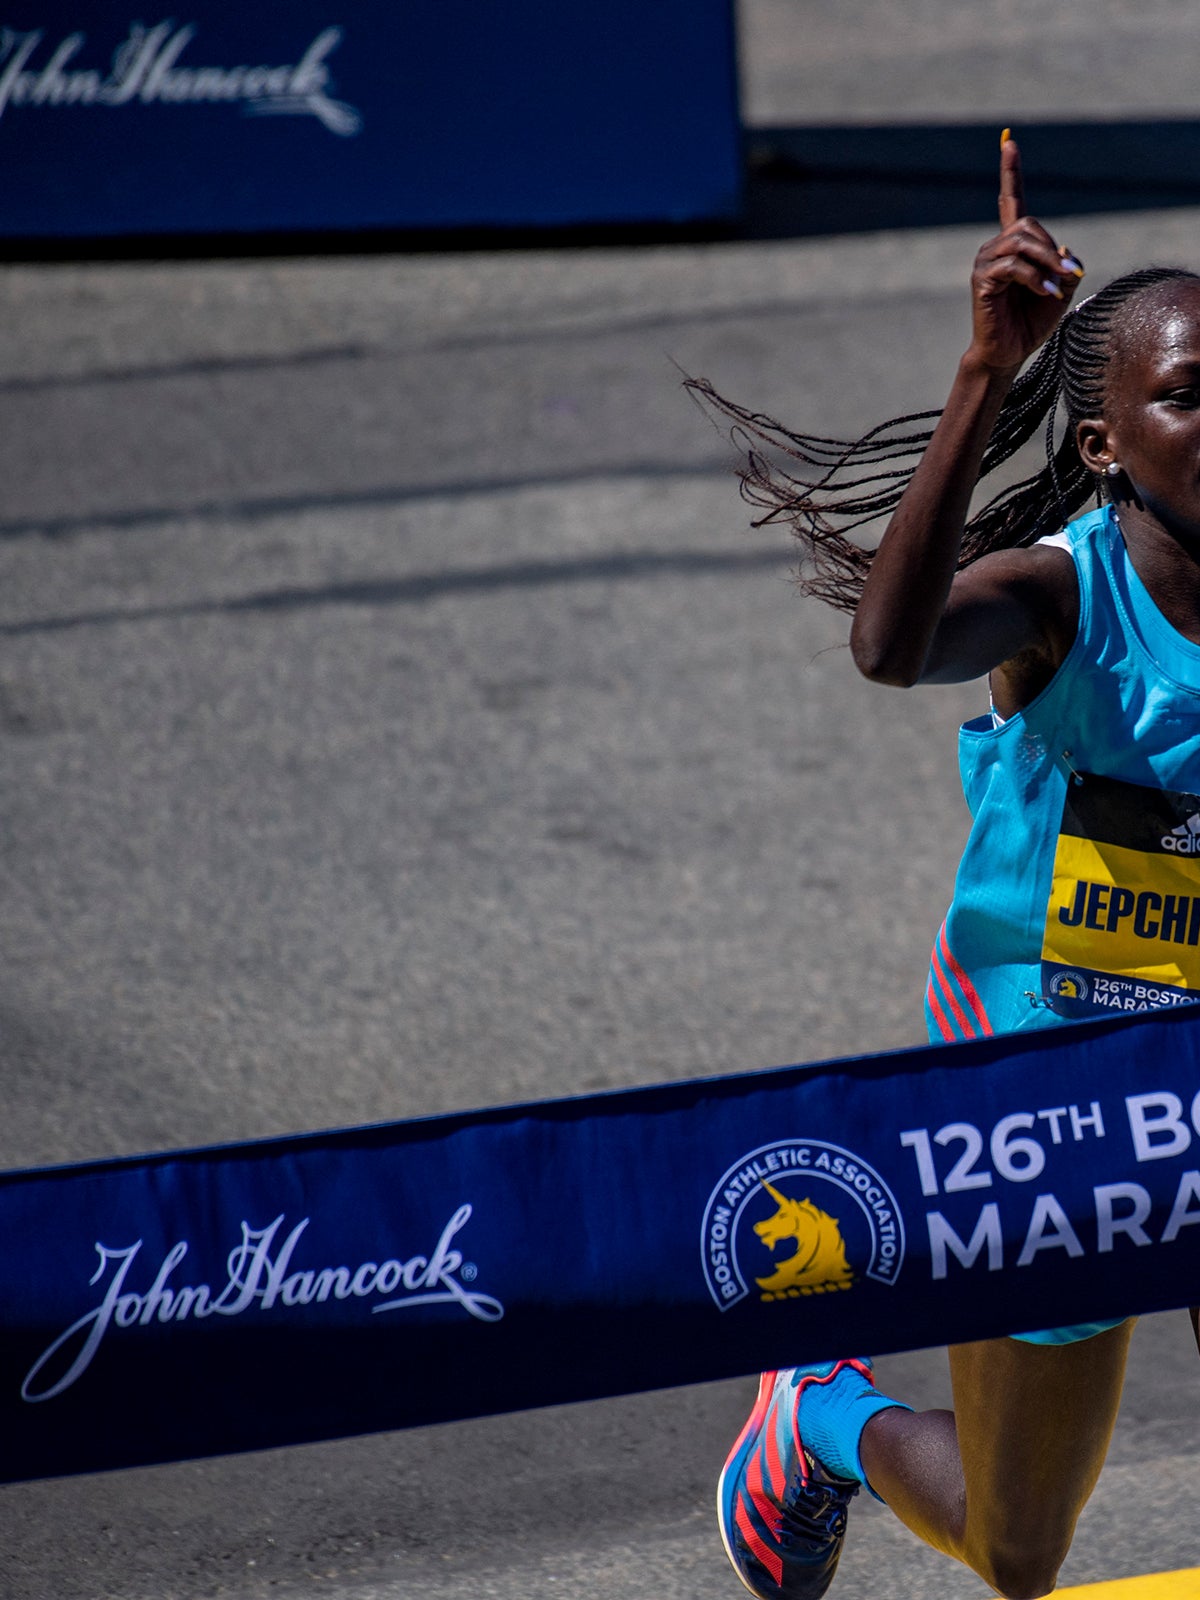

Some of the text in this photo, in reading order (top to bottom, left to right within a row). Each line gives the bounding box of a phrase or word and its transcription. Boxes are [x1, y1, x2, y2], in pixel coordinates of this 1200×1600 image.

[99, 17, 364, 136] Hancock
[1093, 977, 1133, 994] 126TH
[1134, 985, 1198, 1006] BOSTO
[900, 1102, 1105, 1196] 126TH
[711, 1149, 897, 1299] BOSTON ATHLETIC ASSOCIATION
[21, 1239, 209, 1402] John
